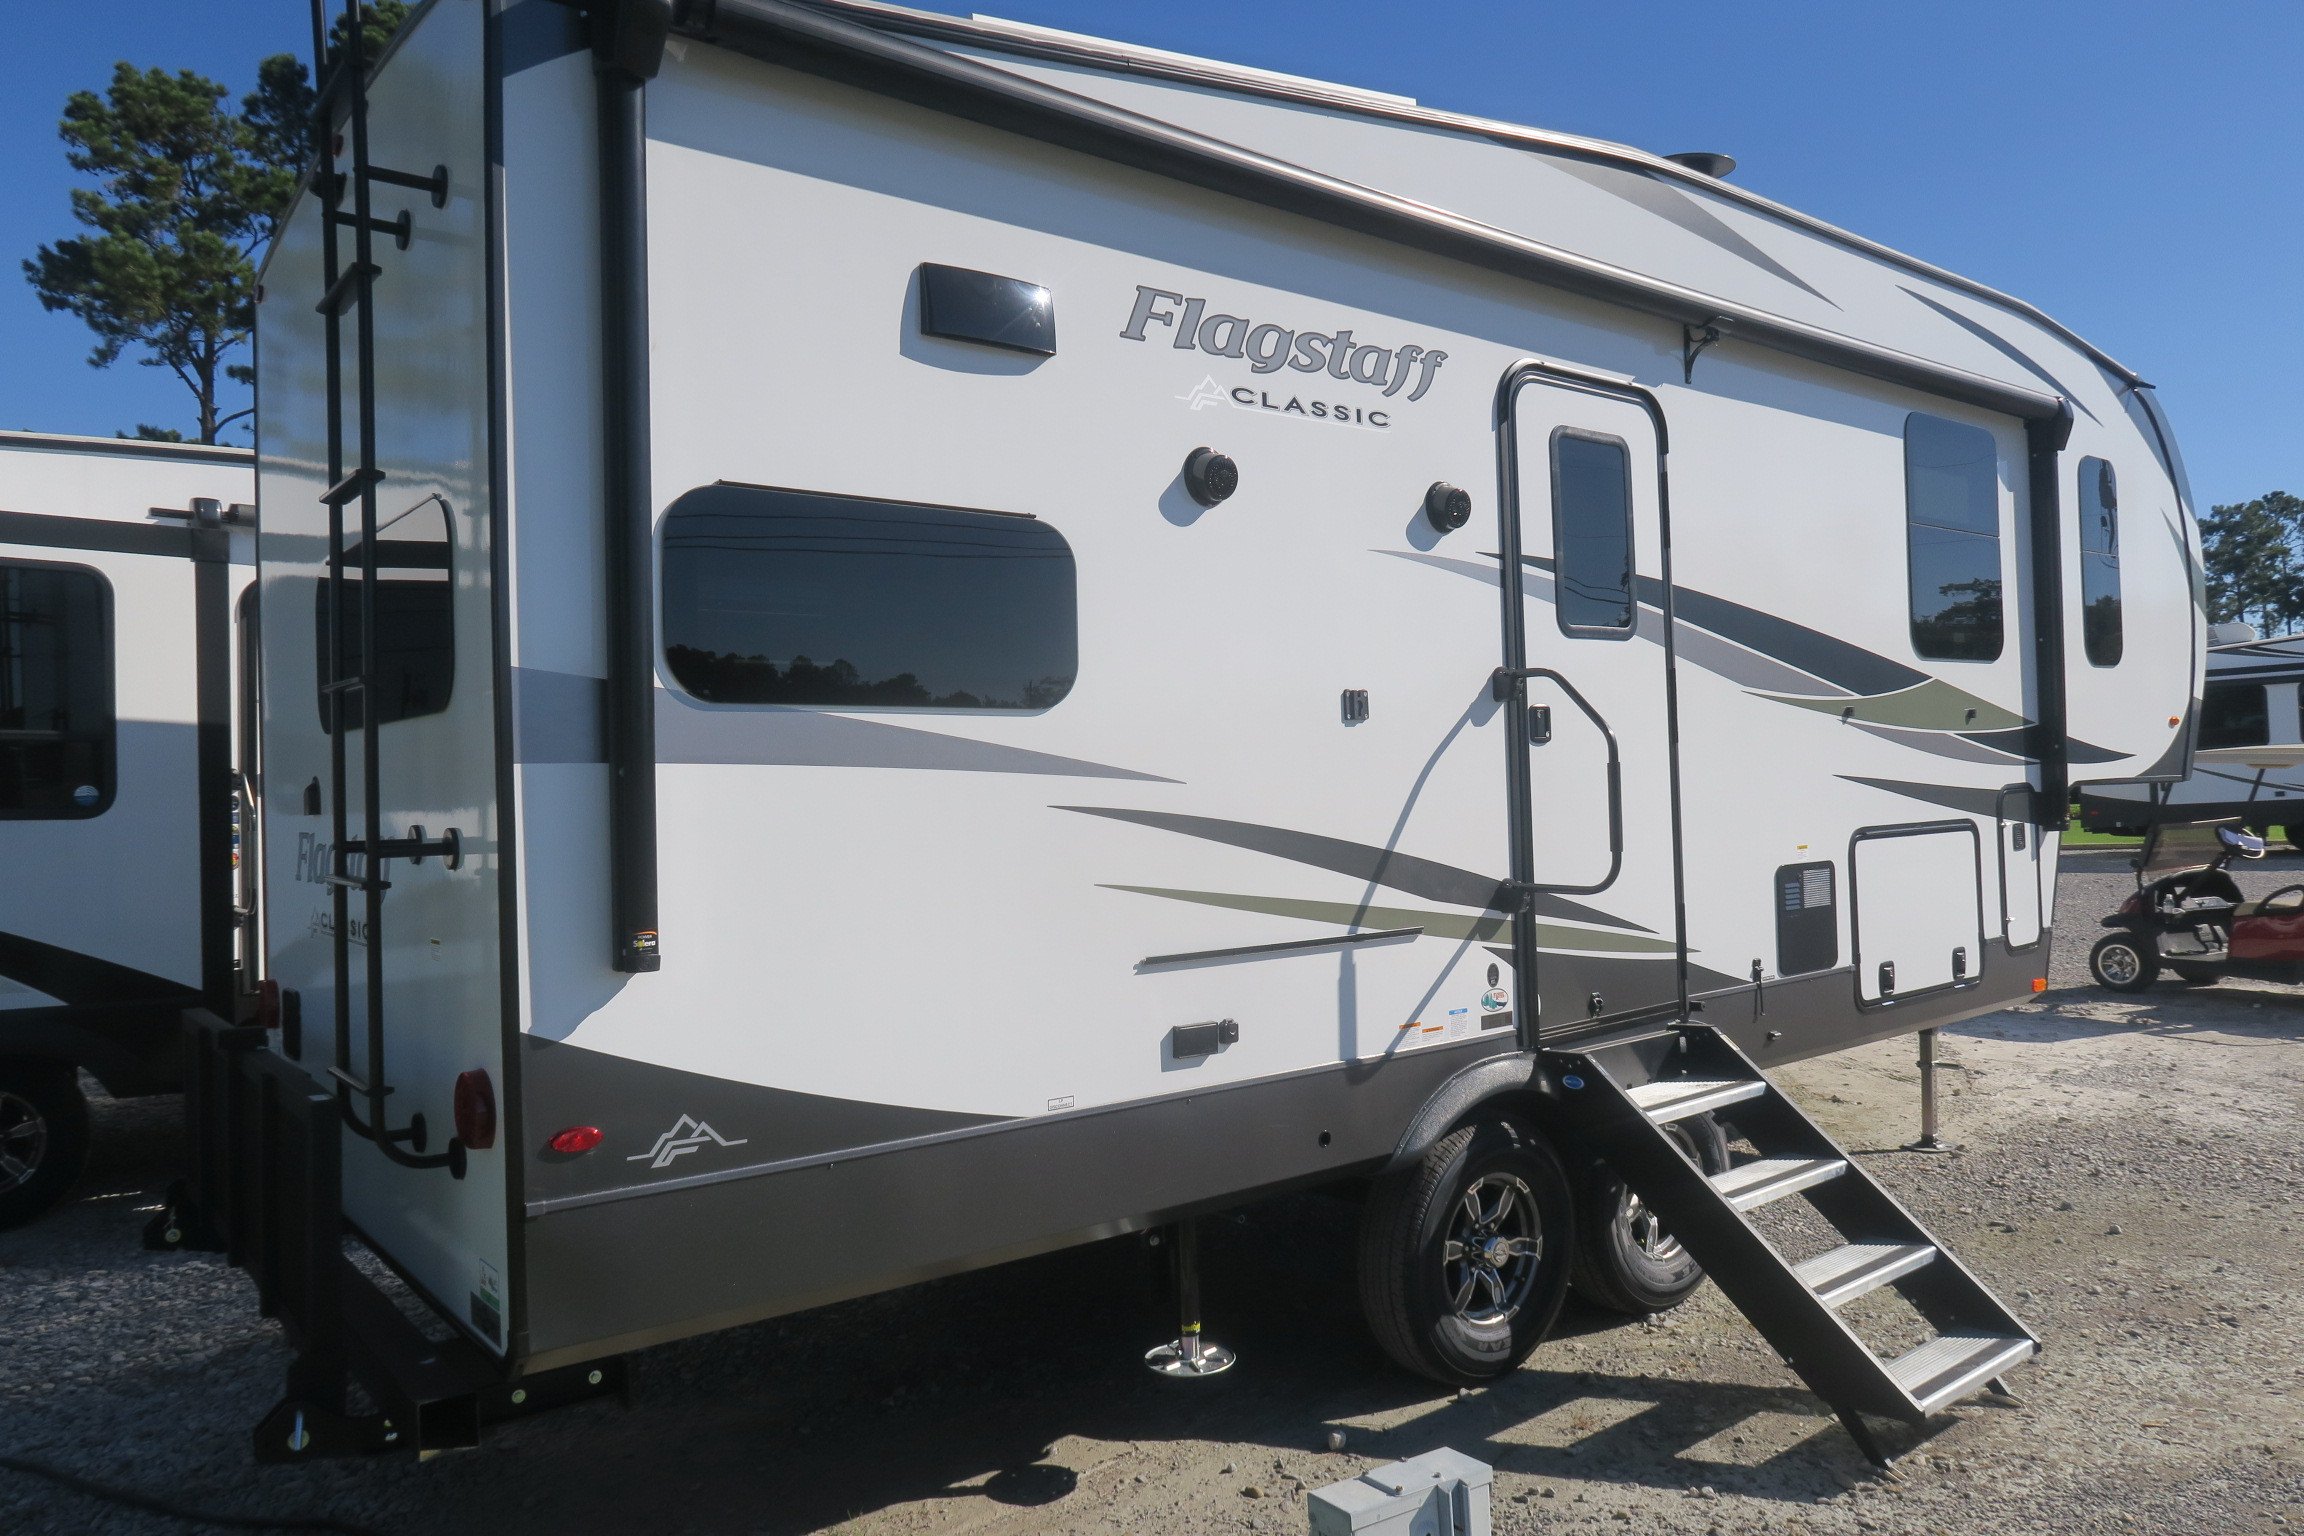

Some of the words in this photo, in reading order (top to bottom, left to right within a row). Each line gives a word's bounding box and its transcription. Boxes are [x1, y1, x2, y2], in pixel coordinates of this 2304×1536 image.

[1119, 285, 1448, 402] Flagstaff
[1231, 387, 1392, 428] CLASSIC
[321, 912, 368, 940] CLSIC
